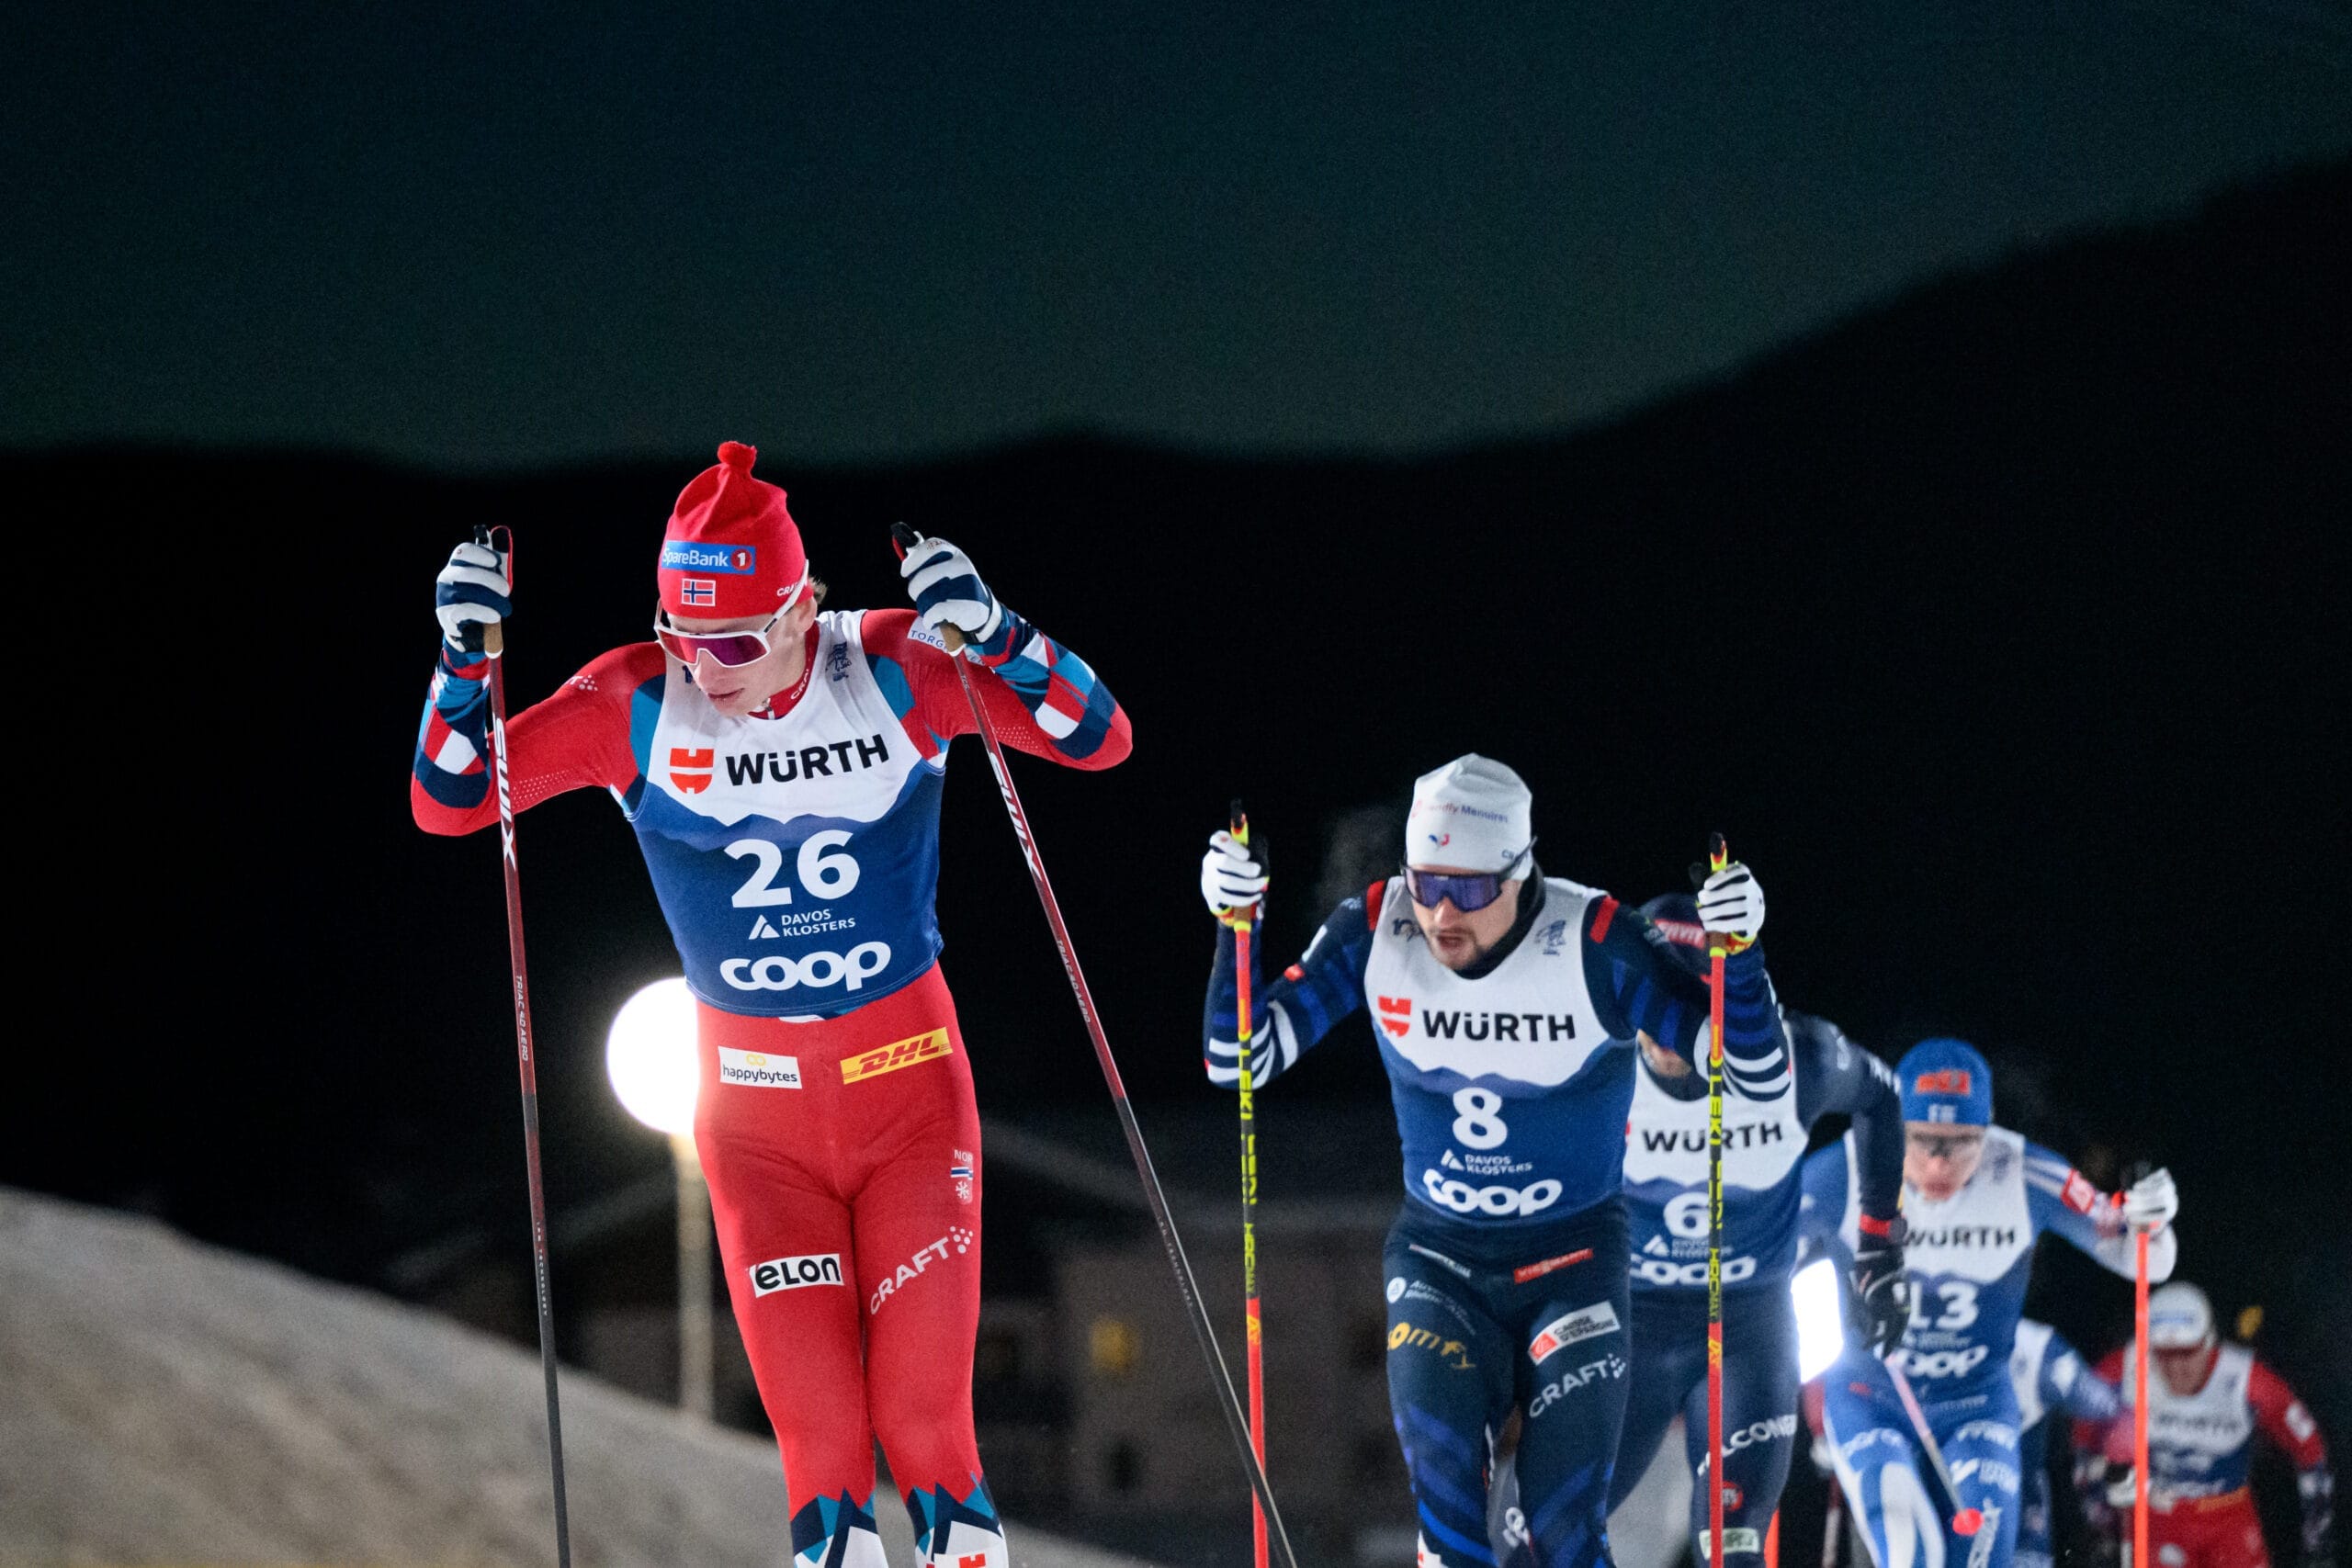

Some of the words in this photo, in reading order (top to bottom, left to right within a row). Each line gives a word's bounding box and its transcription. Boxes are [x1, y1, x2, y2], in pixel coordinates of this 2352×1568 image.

[662, 548, 729, 567] SpareBank
[736, 552, 747, 567] 1
[725, 734, 889, 787] WÜRTH
[724, 829, 861, 908] 26
[781, 908, 832, 926] DAVOS
[783, 918, 856, 937] KLOSTERS
[719, 941, 892, 993] coop
[1423, 1010, 1577, 1043] WÜRTH
[722, 1064, 798, 1084] happybytes
[859, 1035, 944, 1075] DHL
[1453, 1087, 1508, 1150] 8
[1710, 1075, 1723, 1145] LEKI
[954, 1149, 974, 1165] NOR
[1464, 1154, 1512, 1166] DAVOS
[1423, 1168, 1563, 1217] coop
[1663, 1191, 1711, 1238] 6
[870, 1236, 950, 1315] CRAFT
[1893, 1281, 1979, 1330] 13
[1529, 1359, 1610, 1419] CRAFT
